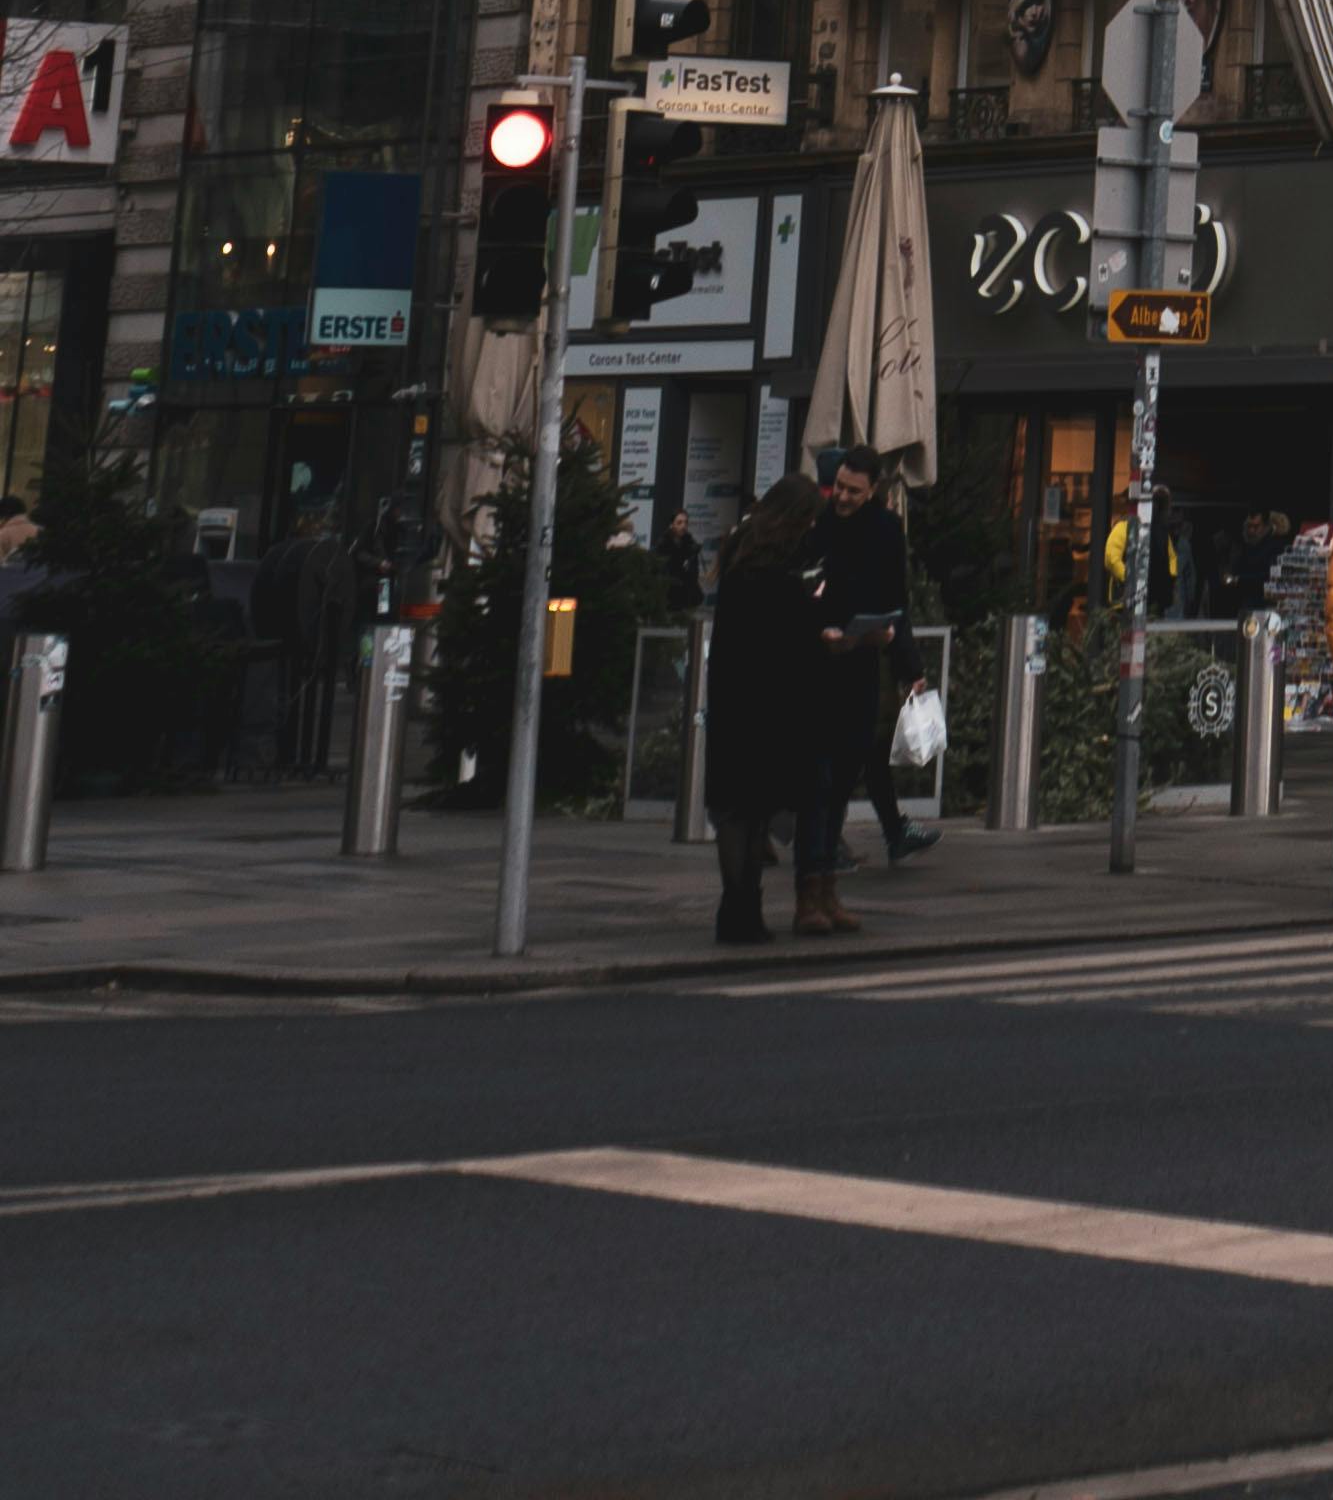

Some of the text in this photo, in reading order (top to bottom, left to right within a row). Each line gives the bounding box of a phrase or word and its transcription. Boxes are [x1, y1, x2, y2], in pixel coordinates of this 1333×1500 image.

[9, 39, 116, 148] A1
[682, 68, 771, 94] FasTest
[656, 98, 698, 112] Corona
[319, 315, 387, 340] ERSTE
[589, 352, 623, 367] Corona
